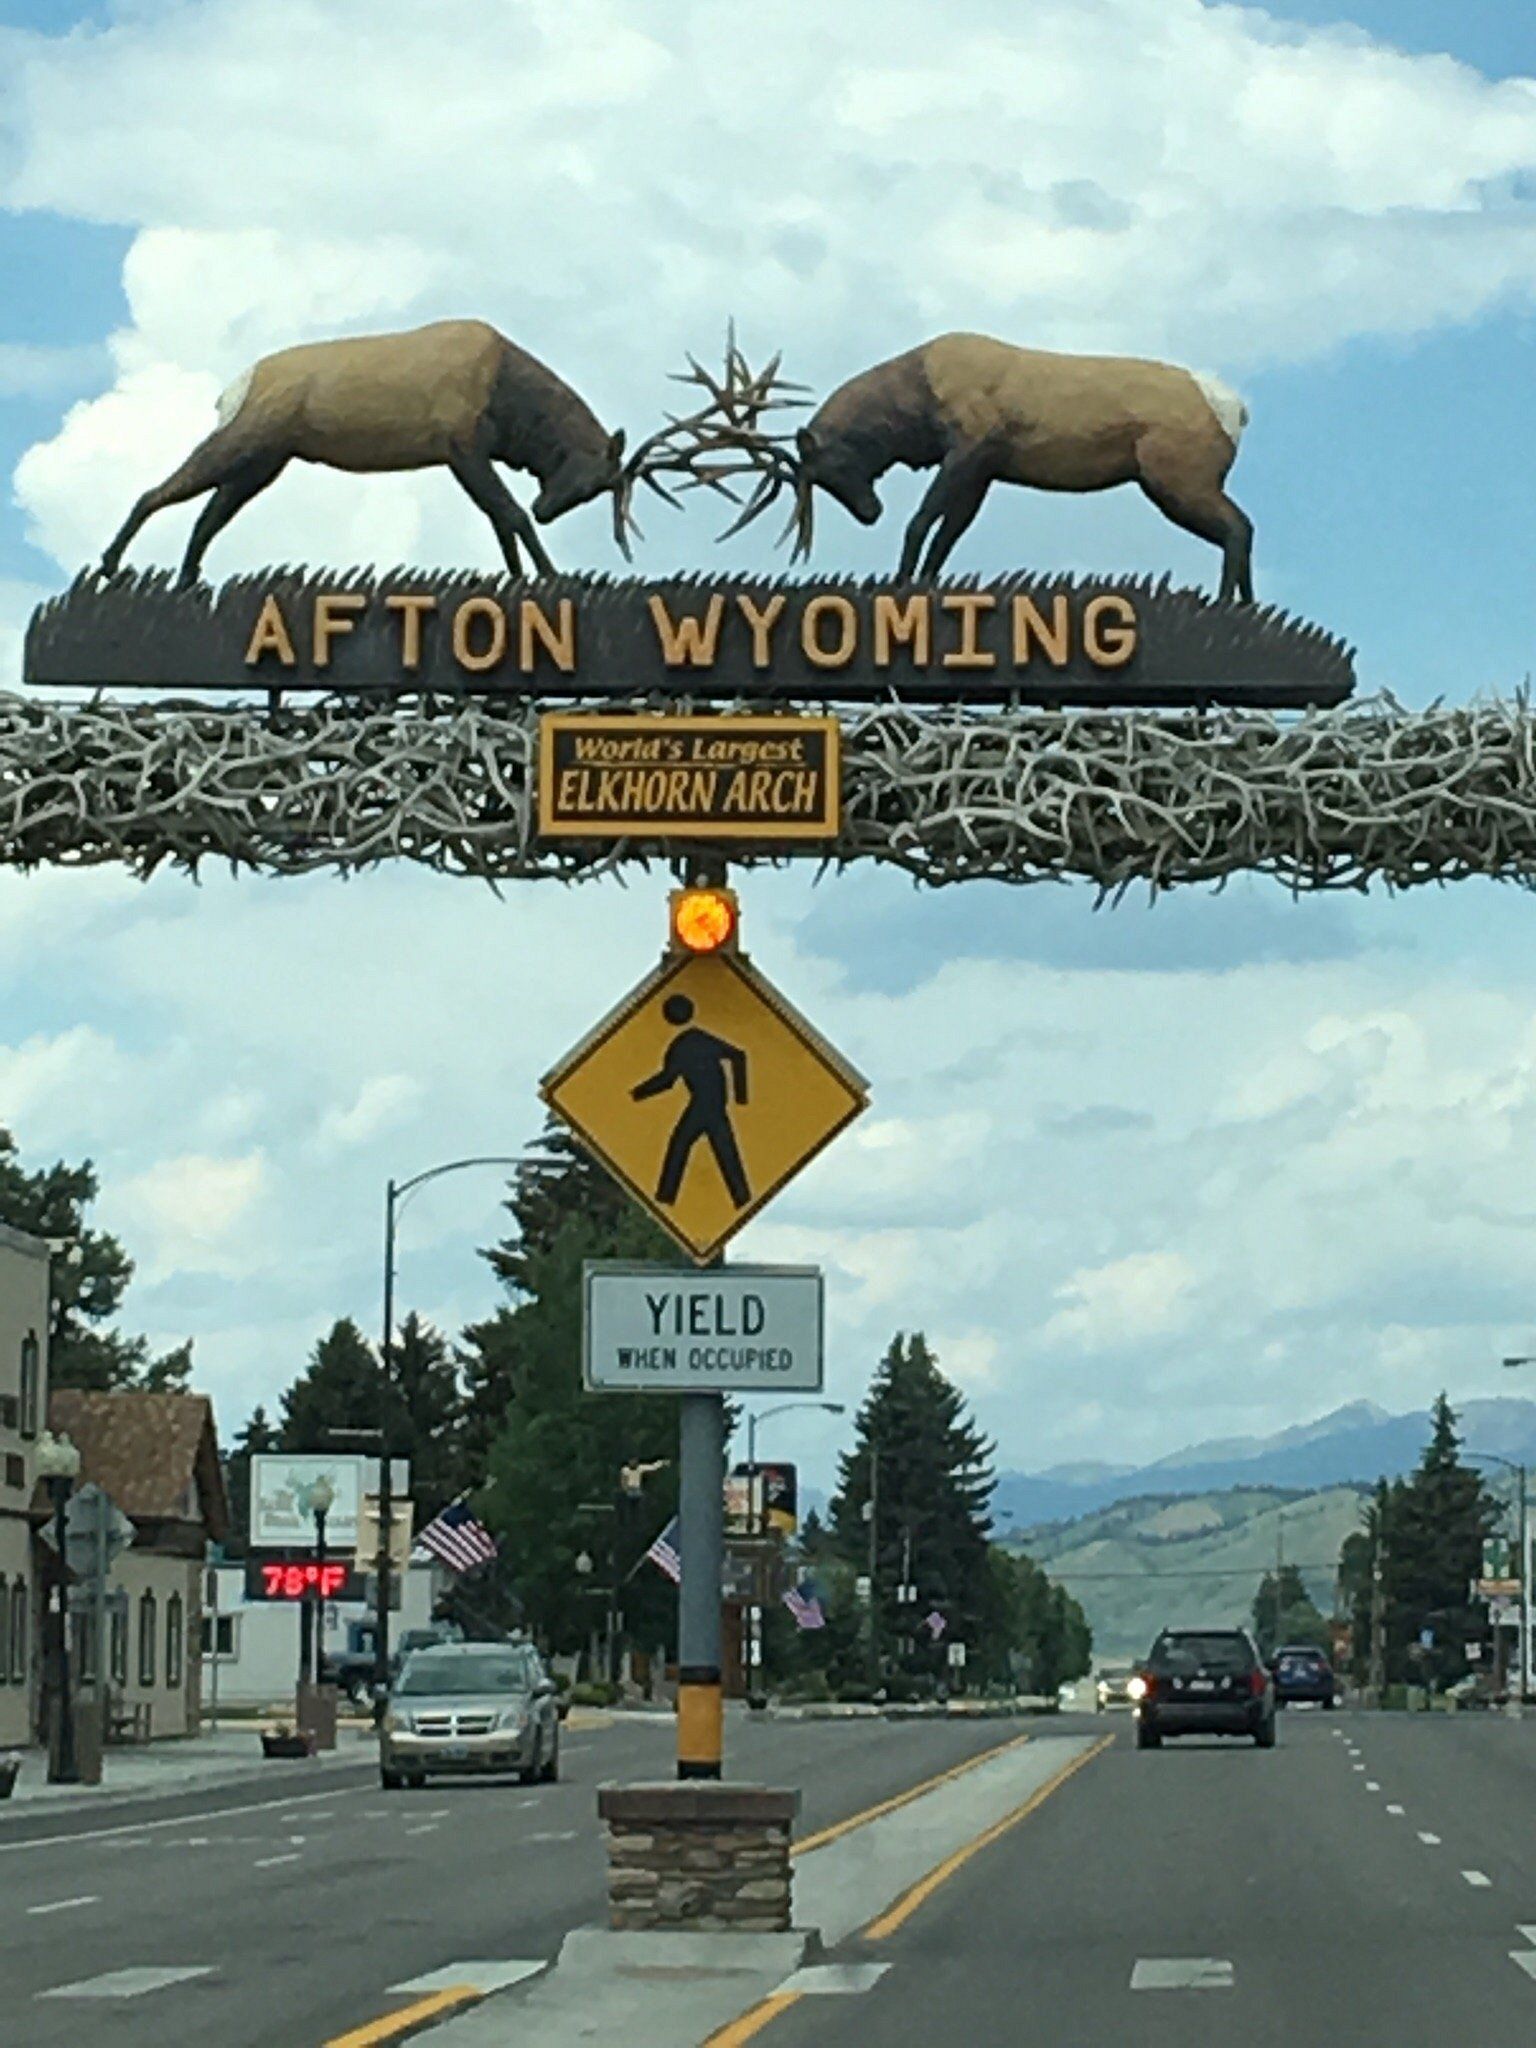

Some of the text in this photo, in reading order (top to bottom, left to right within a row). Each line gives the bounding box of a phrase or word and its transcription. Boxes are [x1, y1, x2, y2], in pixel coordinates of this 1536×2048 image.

[245, 593, 1138, 673] AFTON WYOMING
[574, 737, 803, 763] World's Largest
[557, 770, 817, 813] ELKHORN ARCH
[645, 1294, 764, 1336] YIELD
[617, 1347, 792, 1371] WHEN OCCUPIED
